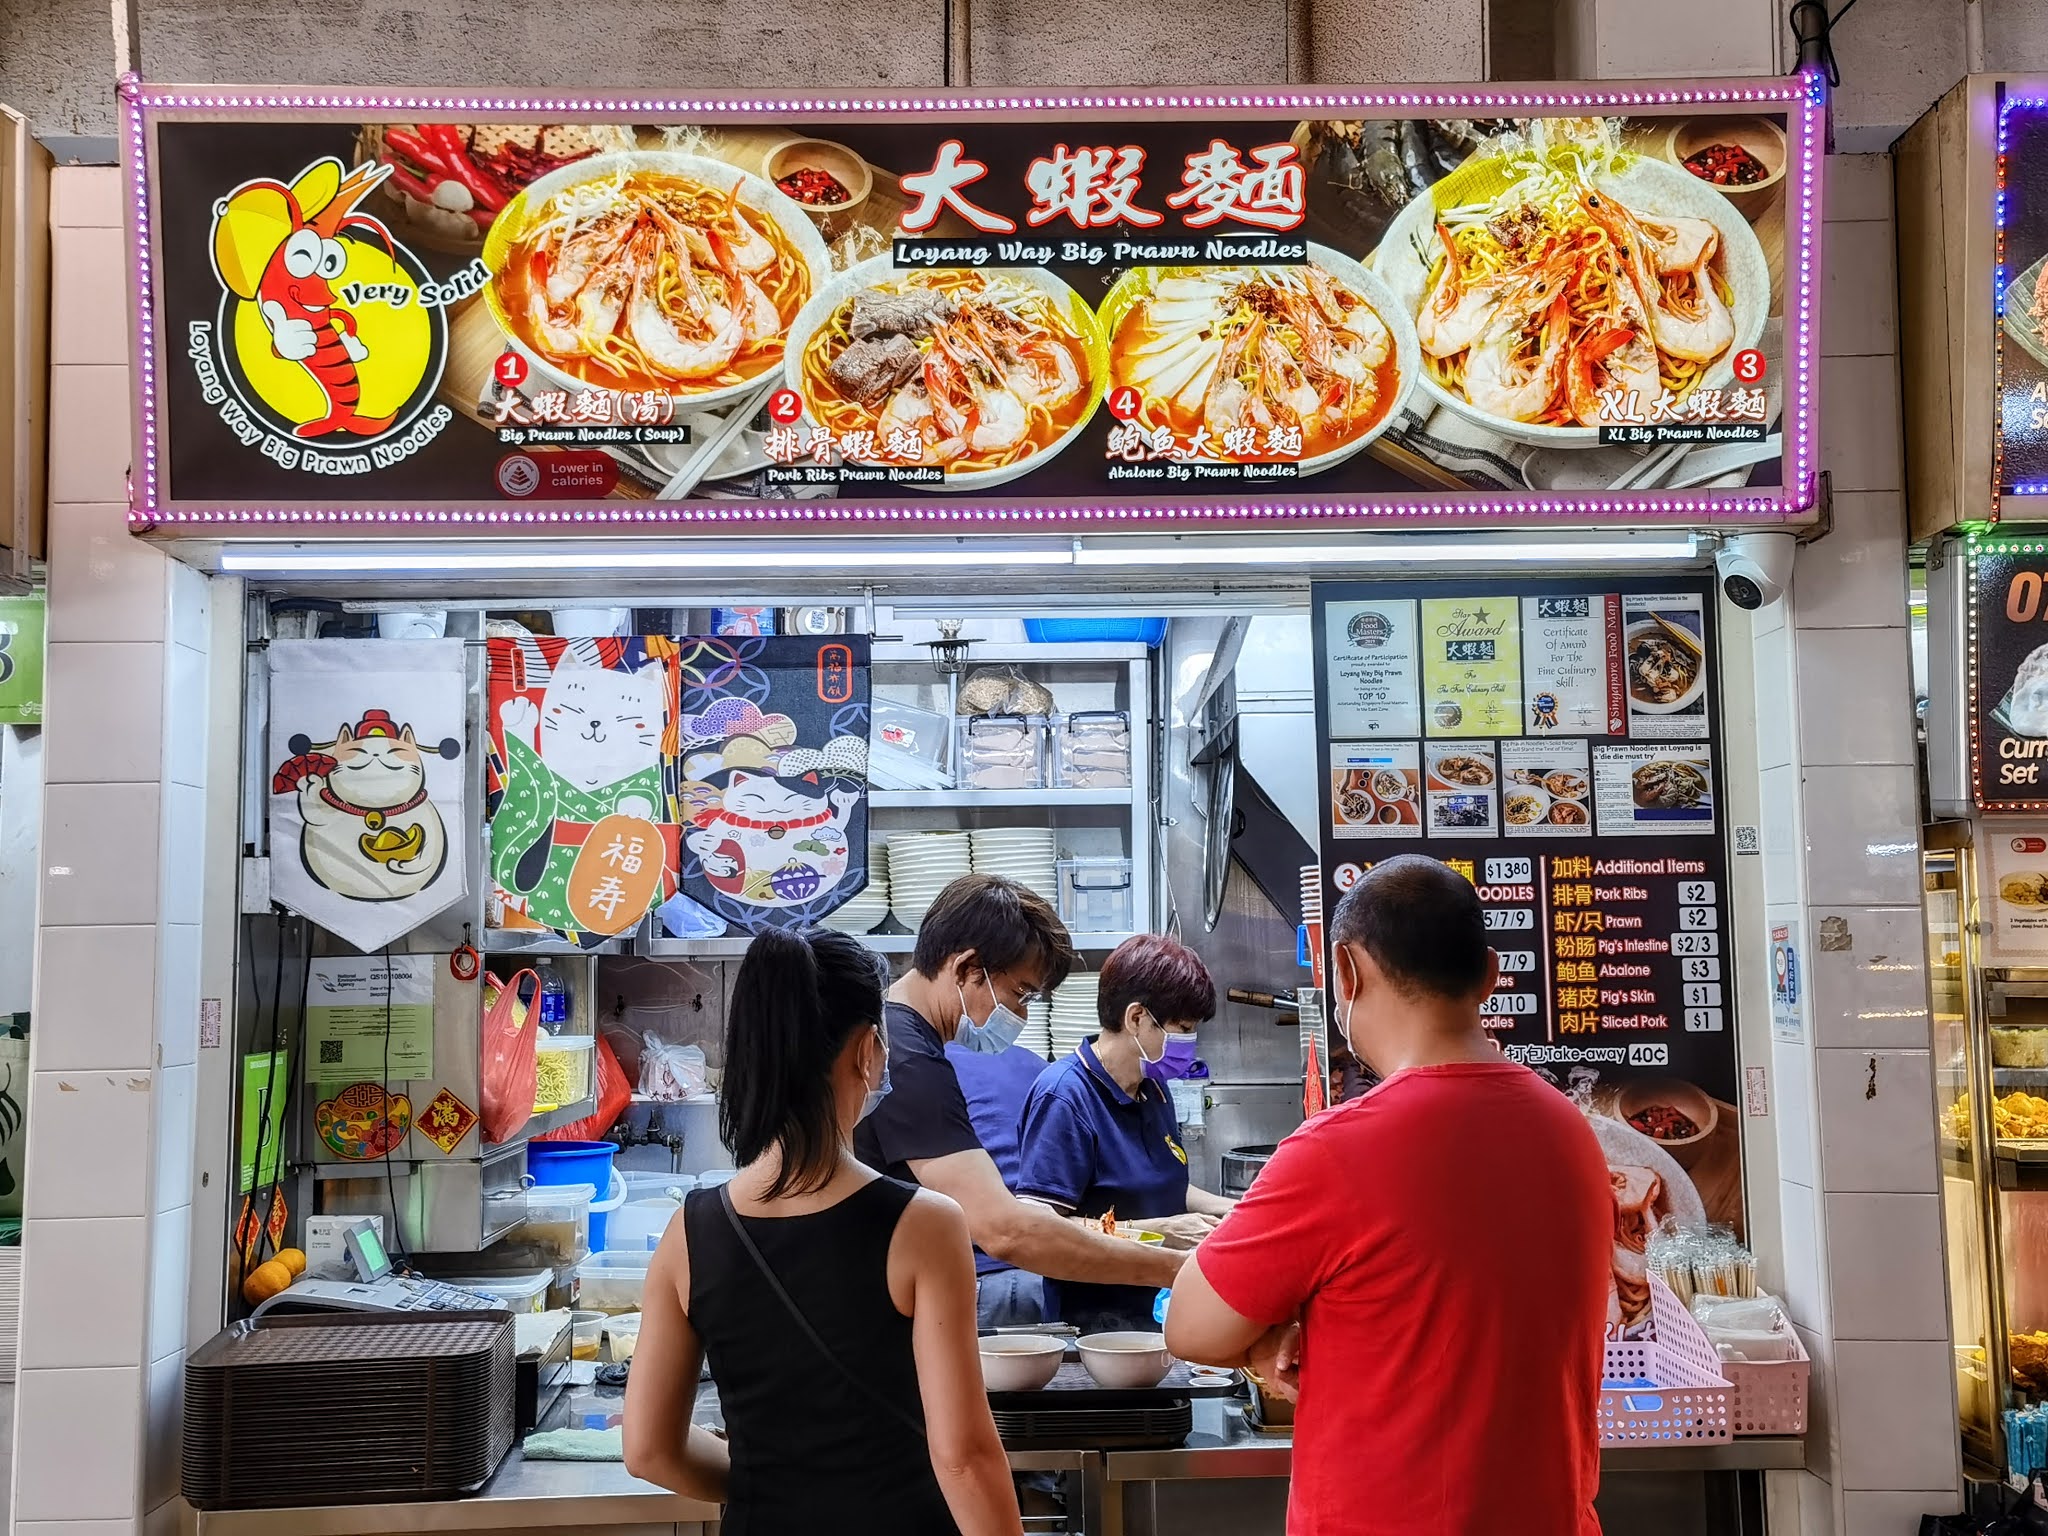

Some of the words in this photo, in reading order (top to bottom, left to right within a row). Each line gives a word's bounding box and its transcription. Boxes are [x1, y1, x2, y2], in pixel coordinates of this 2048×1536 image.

[900, 138, 1306, 233] 大蝦麵
[897, 241, 992, 265] Loyang
[999, 241, 1055, 265] Way
[1061, 242, 1107, 264] Big
[1113, 242, 1200, 260] Prawn
[1205, 240, 1306, 259] Noodles
[341, 282, 411, 307] Very
[418, 260, 490, 306] Solid
[502, 356, 521, 380] 1
[1740, 353, 1758, 378] 3
[190, 322, 226, 403] Loyang
[220, 401, 262, 446] Way
[262, 435, 299, 468] Big
[302, 450, 371, 474] Prawn
[375, 404, 452, 467] Noodles
[777, 394, 795, 416] 2
[1116, 390, 1135, 415] 4
[1600, 389, 1645, 422] XL
[1651, 388, 1767, 422] 大蝦麵
[500, 428, 526, 444] Big
[528, 428, 576, 442] Prawn
[577, 427, 633, 441] Noodles
[764, 427, 924, 464] 排骨蝦麵
[1105, 424, 1303, 462] 鮑魚大蝦麵
[1608, 428, 1627, 441] XL
[1628, 427, 1654, 443] Big
[1656, 426, 1704, 440] Prawn
[1706, 426, 1760, 439] Noodles
[551, 463, 589, 474] Lower
[592, 462, 604, 472] in
[767, 468, 803, 483] Pork
[805, 468, 837, 482] Ribs
[839, 468, 886, 481] Prawn
[888, 467, 943, 481] Noodles
[1108, 466, 1165, 480] Abalone
[1166, 465, 1192, 481] Big
[1193, 466, 1241, 478] Prawn
[1243, 465, 1298, 477] Noodles
[552, 476, 603, 487] calories
[1608, 601, 1619, 628] Map
[1437, 619, 1505, 637] Award
[1543, 626, 1588, 638] Certificate
[1546, 639, 1557, 651] Of
[1560, 640, 1586, 649] Award
[1607, 632, 1618, 658] Food
[1551, 654, 1564, 662] For
[1567, 651, 1583, 663] The
[1340, 670, 1360, 678] Loyang
[1538, 667, 1555, 675] Fine
[1558, 664, 1596, 676] Culinary
[1358, 692, 1373, 700] TOP
[1375, 692, 1386, 700] 10
[1609, 661, 1622, 717] Singapore
[2000, 737, 2048, 761] Curr
[2000, 763, 2039, 784] Set
[589, 833, 645, 920] 福寿
[1342, 868, 1355, 887] 3
[1551, 856, 1592, 879] 加料
[1594, 859, 1664, 875] Additional
[1667, 859, 1705, 874] Items
[1552, 884, 1593, 906] 排骨
[1594, 888, 1621, 901] Pork
[1623, 887, 1648, 900] Ribs
[1687, 884, 1705, 902] $2
[1554, 911, 1604, 932] 虾/只
[1605, 916, 1642, 928] Prawn
[1688, 908, 1707, 927] $2
[1555, 936, 1597, 957] 粉肠
[1598, 941, 1623, 955] Pig's
[1624, 939, 1669, 951] Intestine
[1677, 936, 1711, 953] $2/3
[1556, 961, 1598, 982] 鲍鱼
[1599, 964, 1651, 977] Abalone
[1691, 960, 1710, 978] $3
[1557, 987, 1599, 1008] 猪皮
[1600, 991, 1629, 1004] Pig's
[1630, 990, 1655, 1002] Skin
[1692, 986, 1708, 1004] $1
[1559, 1011, 1600, 1033] 肉片
[1602, 1015, 1639, 1028] Sliced
[1641, 1014, 1668, 1028] Pork
[1694, 1012, 1709, 1029] $1
[1505, 1044, 1547, 1063] 打包
[1546, 1045, 1626, 1063] Take-away
[1631, 1046, 1666, 1063] 40¢
